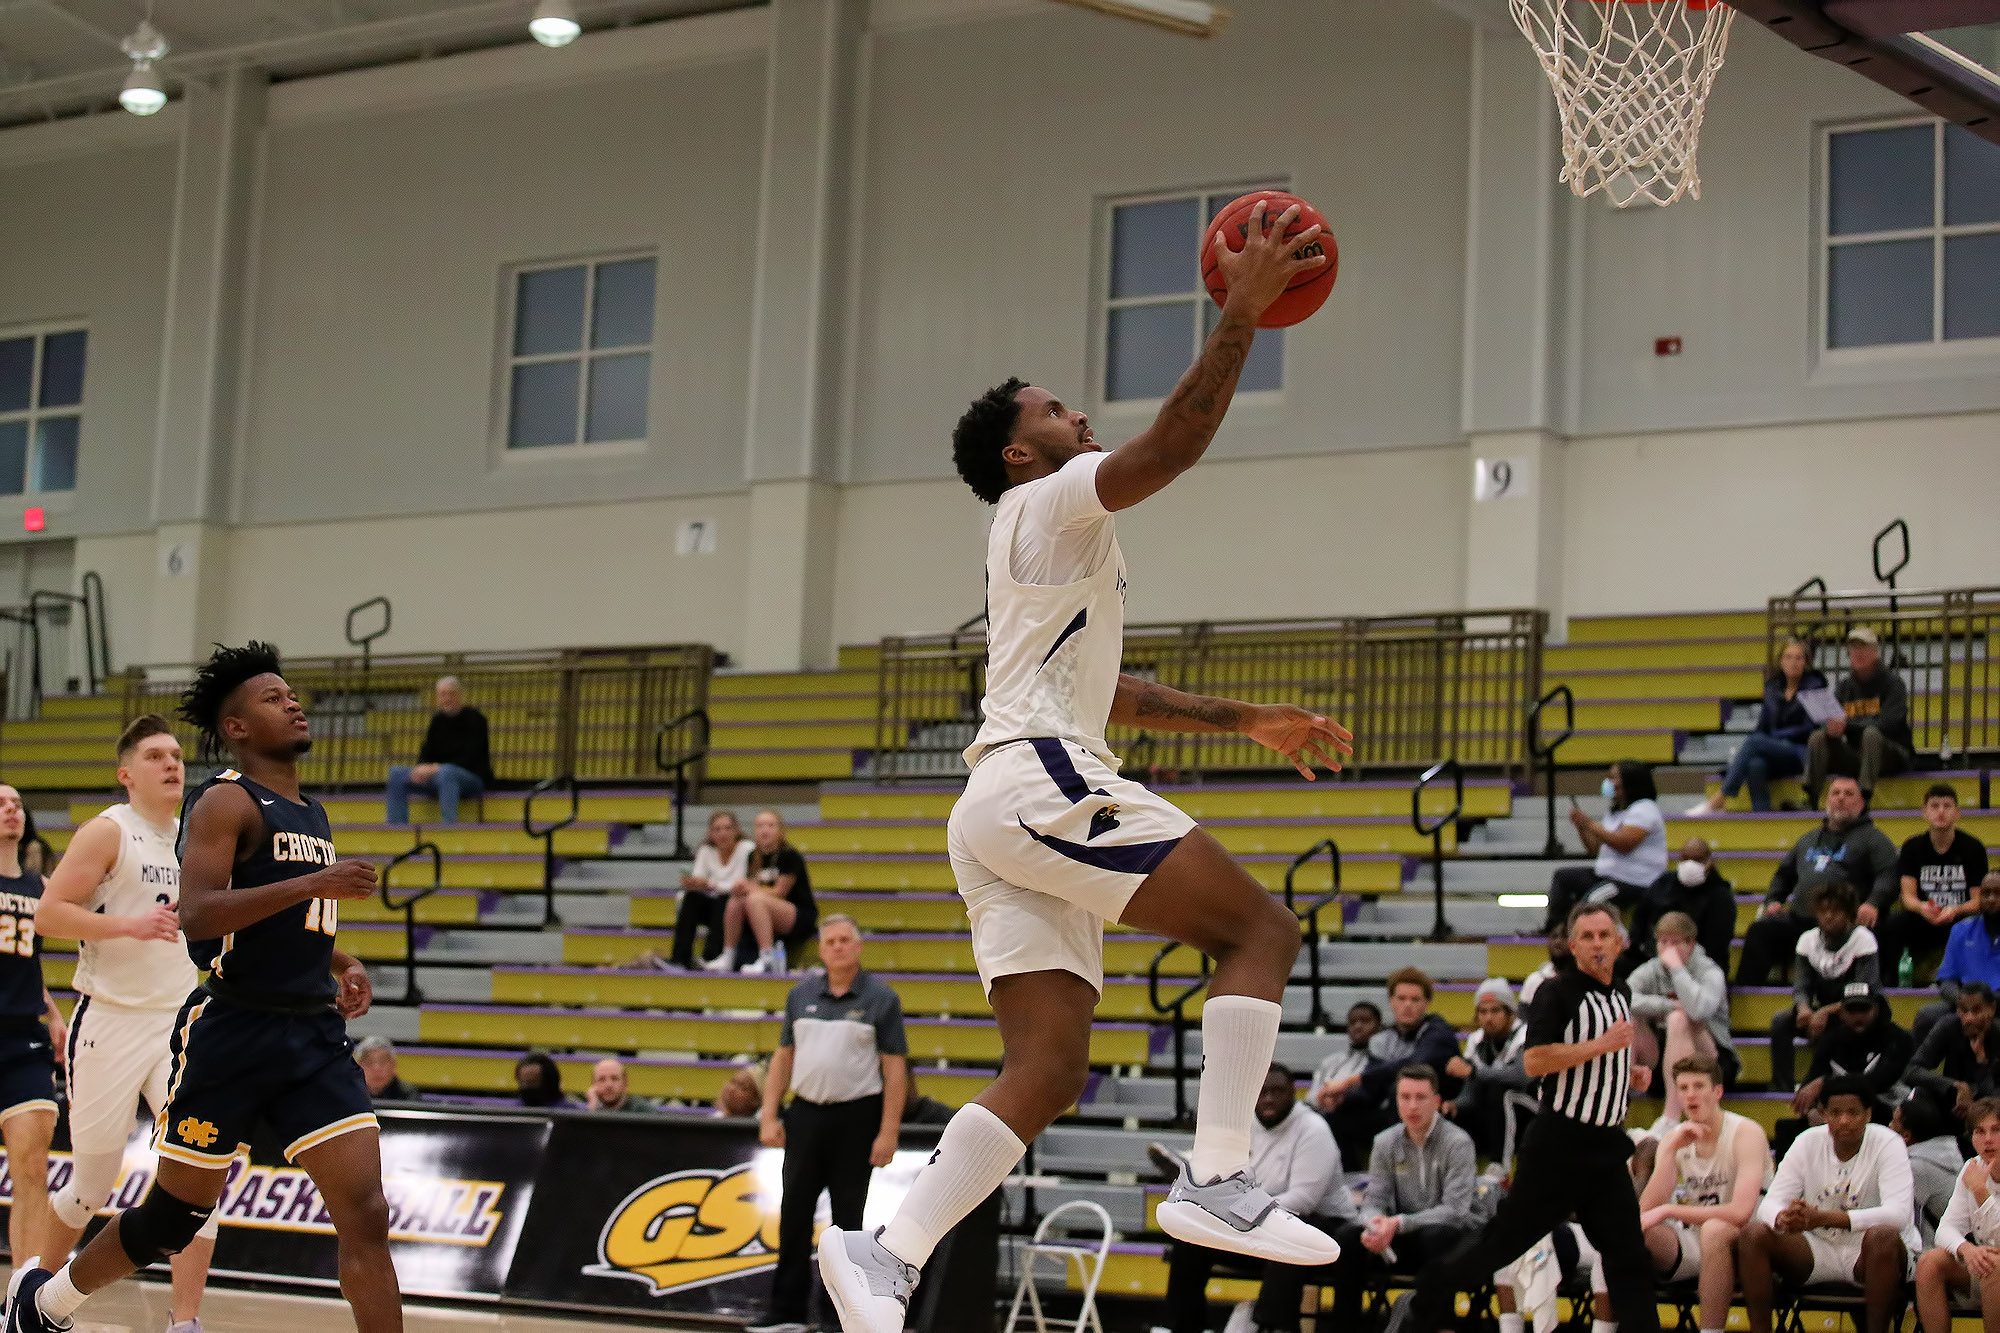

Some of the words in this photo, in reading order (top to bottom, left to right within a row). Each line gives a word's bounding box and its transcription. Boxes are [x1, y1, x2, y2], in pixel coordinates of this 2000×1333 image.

[1492, 460, 1511, 498] 9
[688, 522, 704, 552] 7
[167, 545, 183, 574] 6
[0, 913, 35, 957] 23
[304, 897, 338, 936] 10
